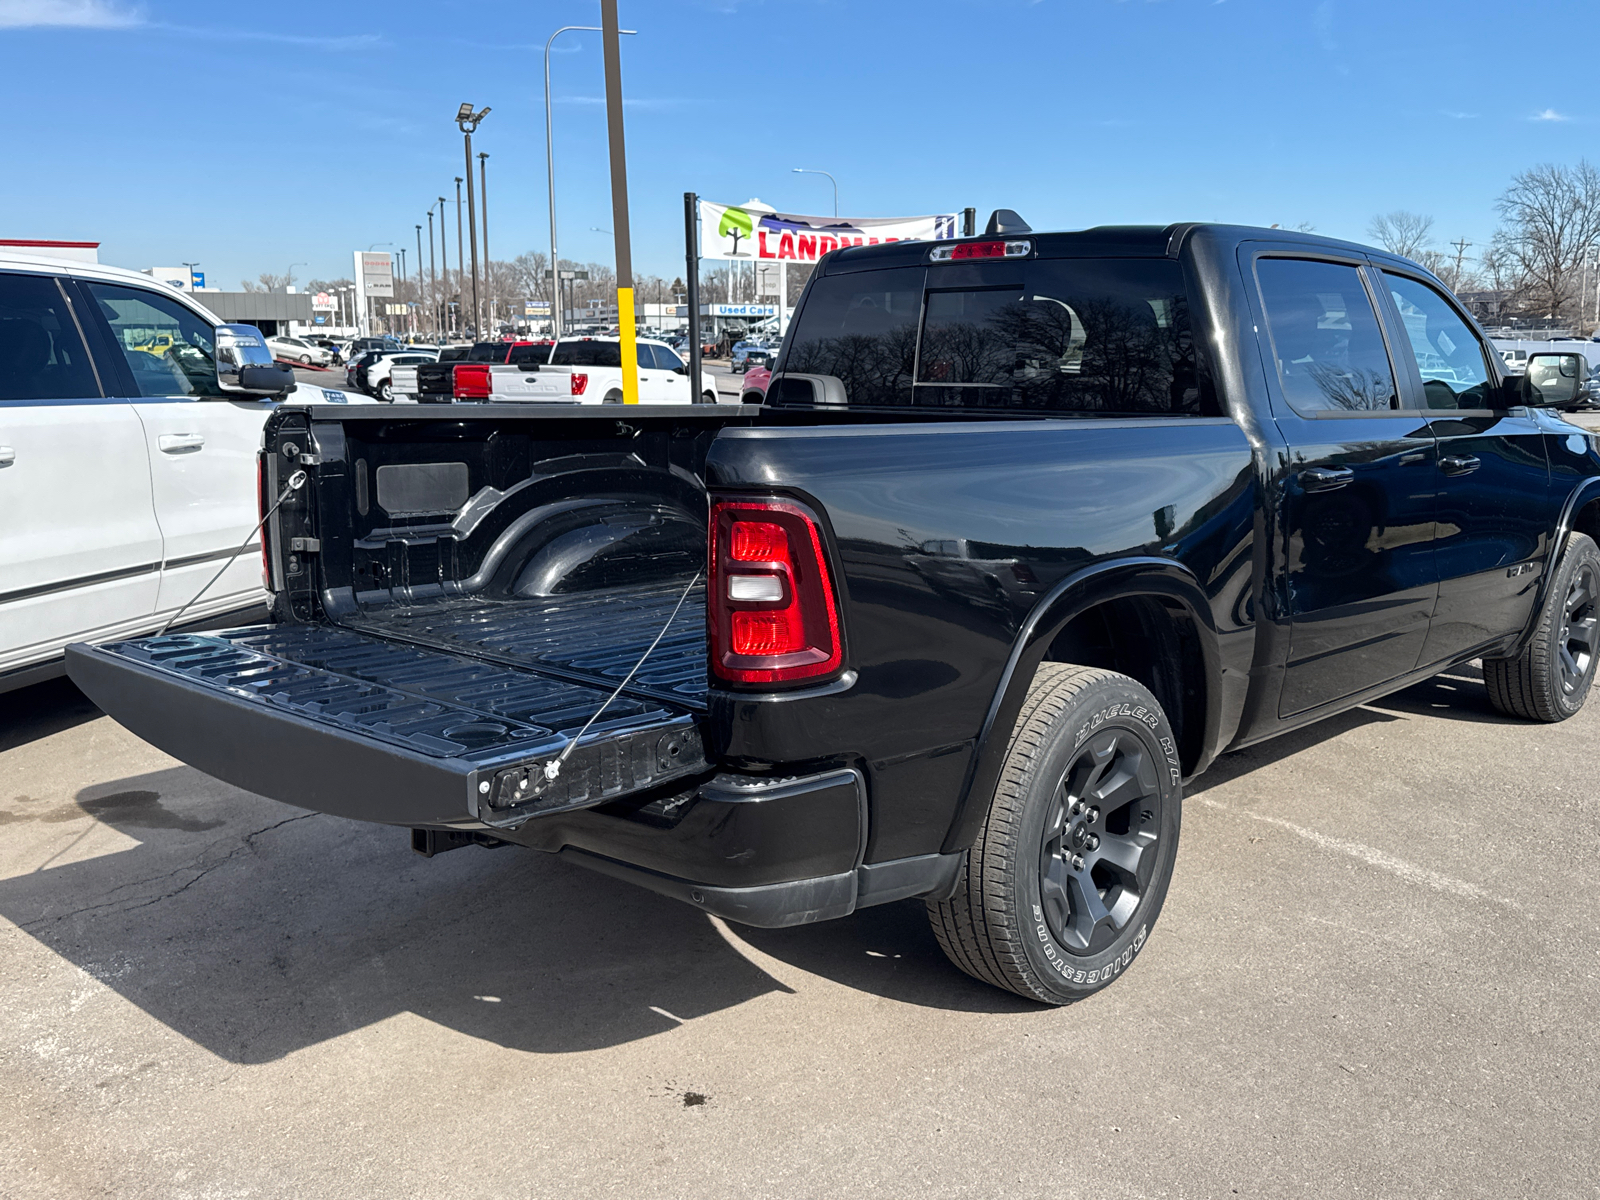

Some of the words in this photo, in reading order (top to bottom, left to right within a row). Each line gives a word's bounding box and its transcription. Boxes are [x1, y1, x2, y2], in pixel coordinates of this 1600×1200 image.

[758, 231, 921, 260] LAND
[719, 306, 746, 314] Used
[749, 306, 773, 314] Cars
[1074, 703, 1159, 748] DUELER
[1160, 736, 1179, 786] H/L
[1032, 905, 1147, 984] BRIDGESTONE
